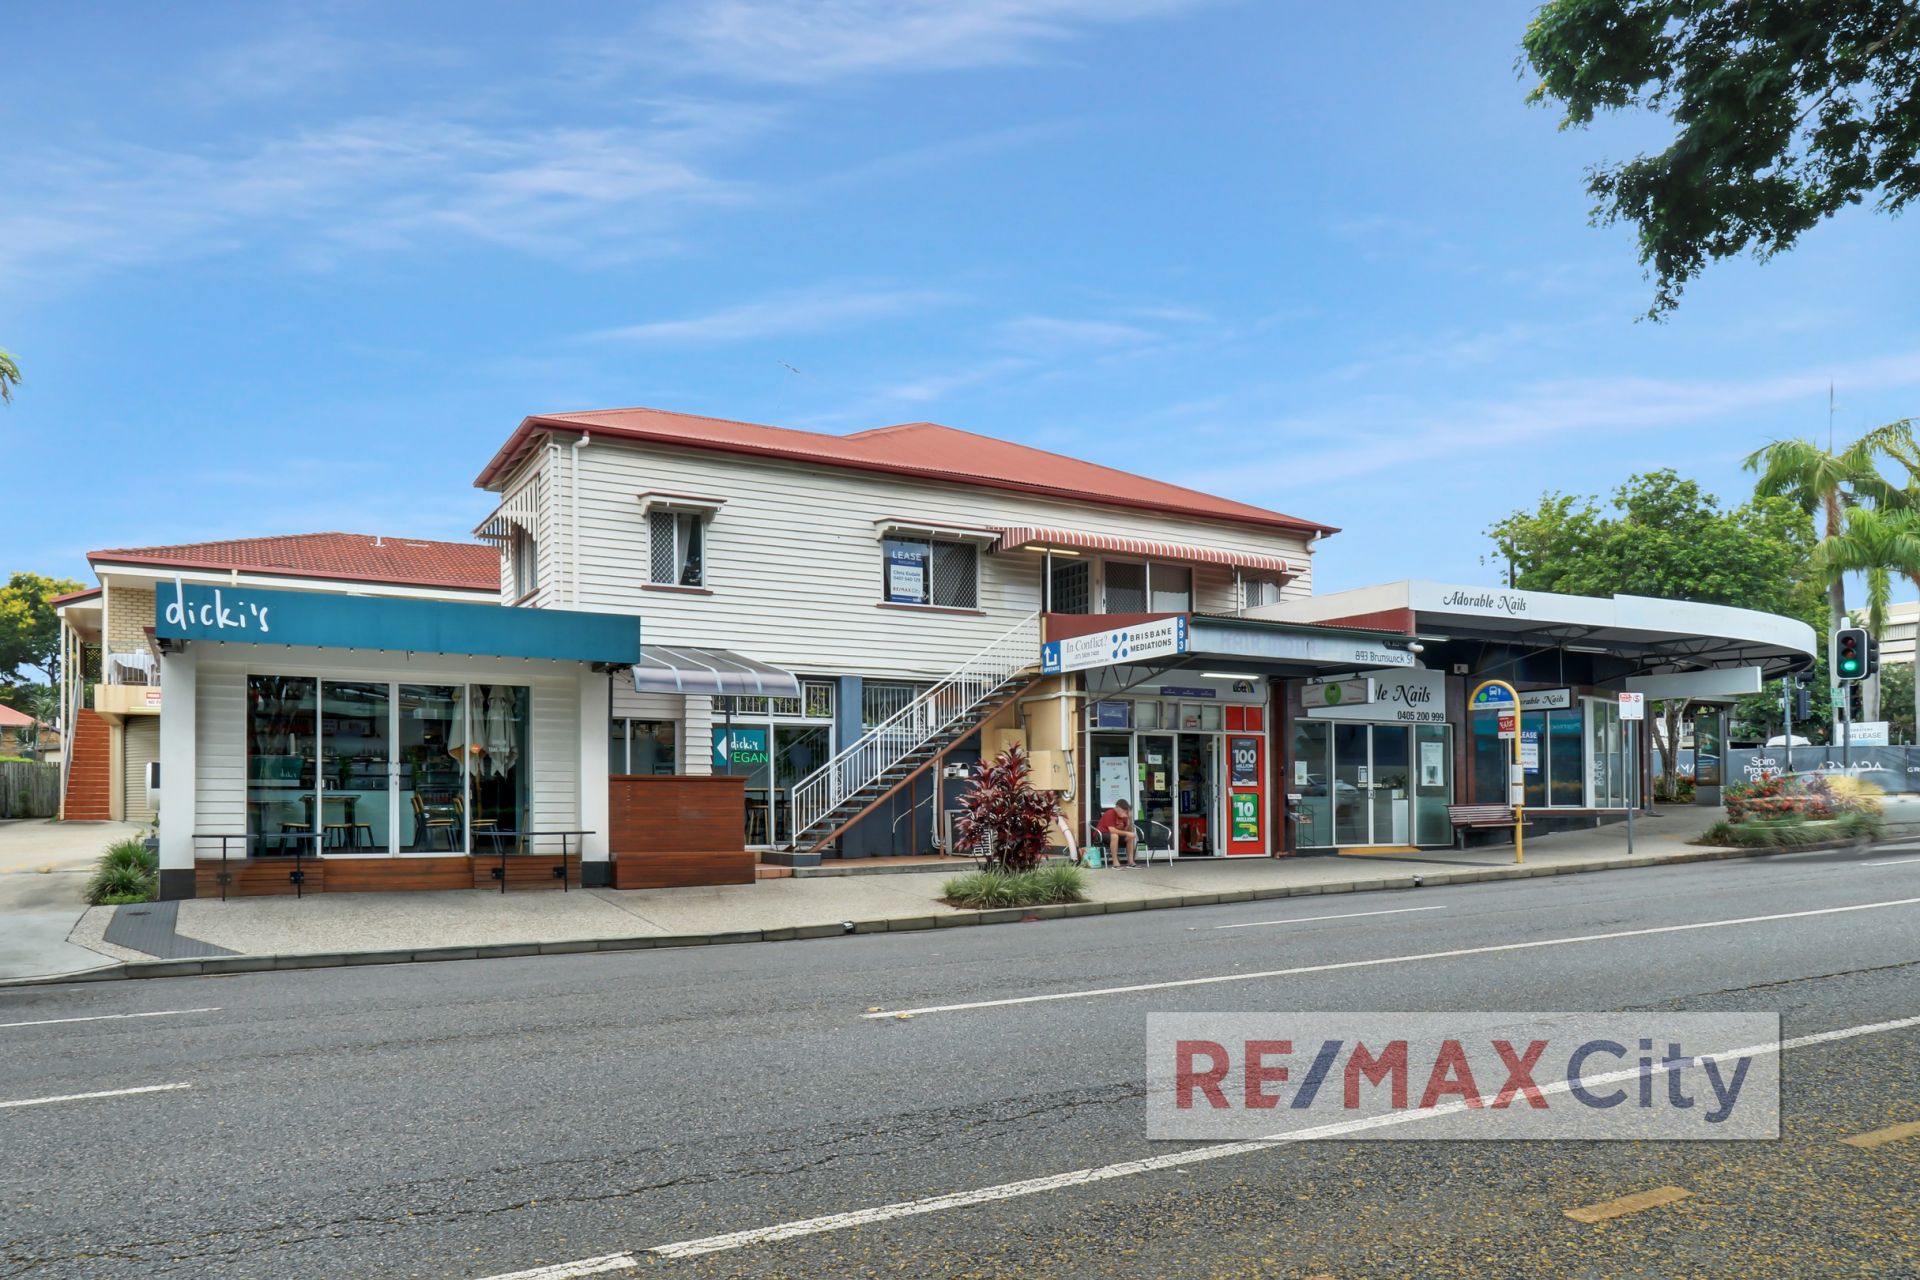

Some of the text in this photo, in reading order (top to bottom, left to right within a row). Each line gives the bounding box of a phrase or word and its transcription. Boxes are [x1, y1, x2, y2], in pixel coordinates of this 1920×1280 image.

[892, 551, 922, 561] LEASE
[165, 573, 269, 632] dicki's
[1443, 591, 1526, 615] Adorable Nails
[1130, 628, 1172, 642] BRISBANE
[1066, 634, 1108, 653] In Conflict?
[1130, 639, 1172, 652] MEDIATIONS
[1355, 650, 1413, 664] 893 Brunswick St
[1392, 684, 1430, 708] Nails
[1542, 695, 1564, 705] Nails
[1397, 710, 1444, 721] 0405 200 999
[1752, 756, 1775, 767] Spiro
[1744, 765, 1783, 775] Property
